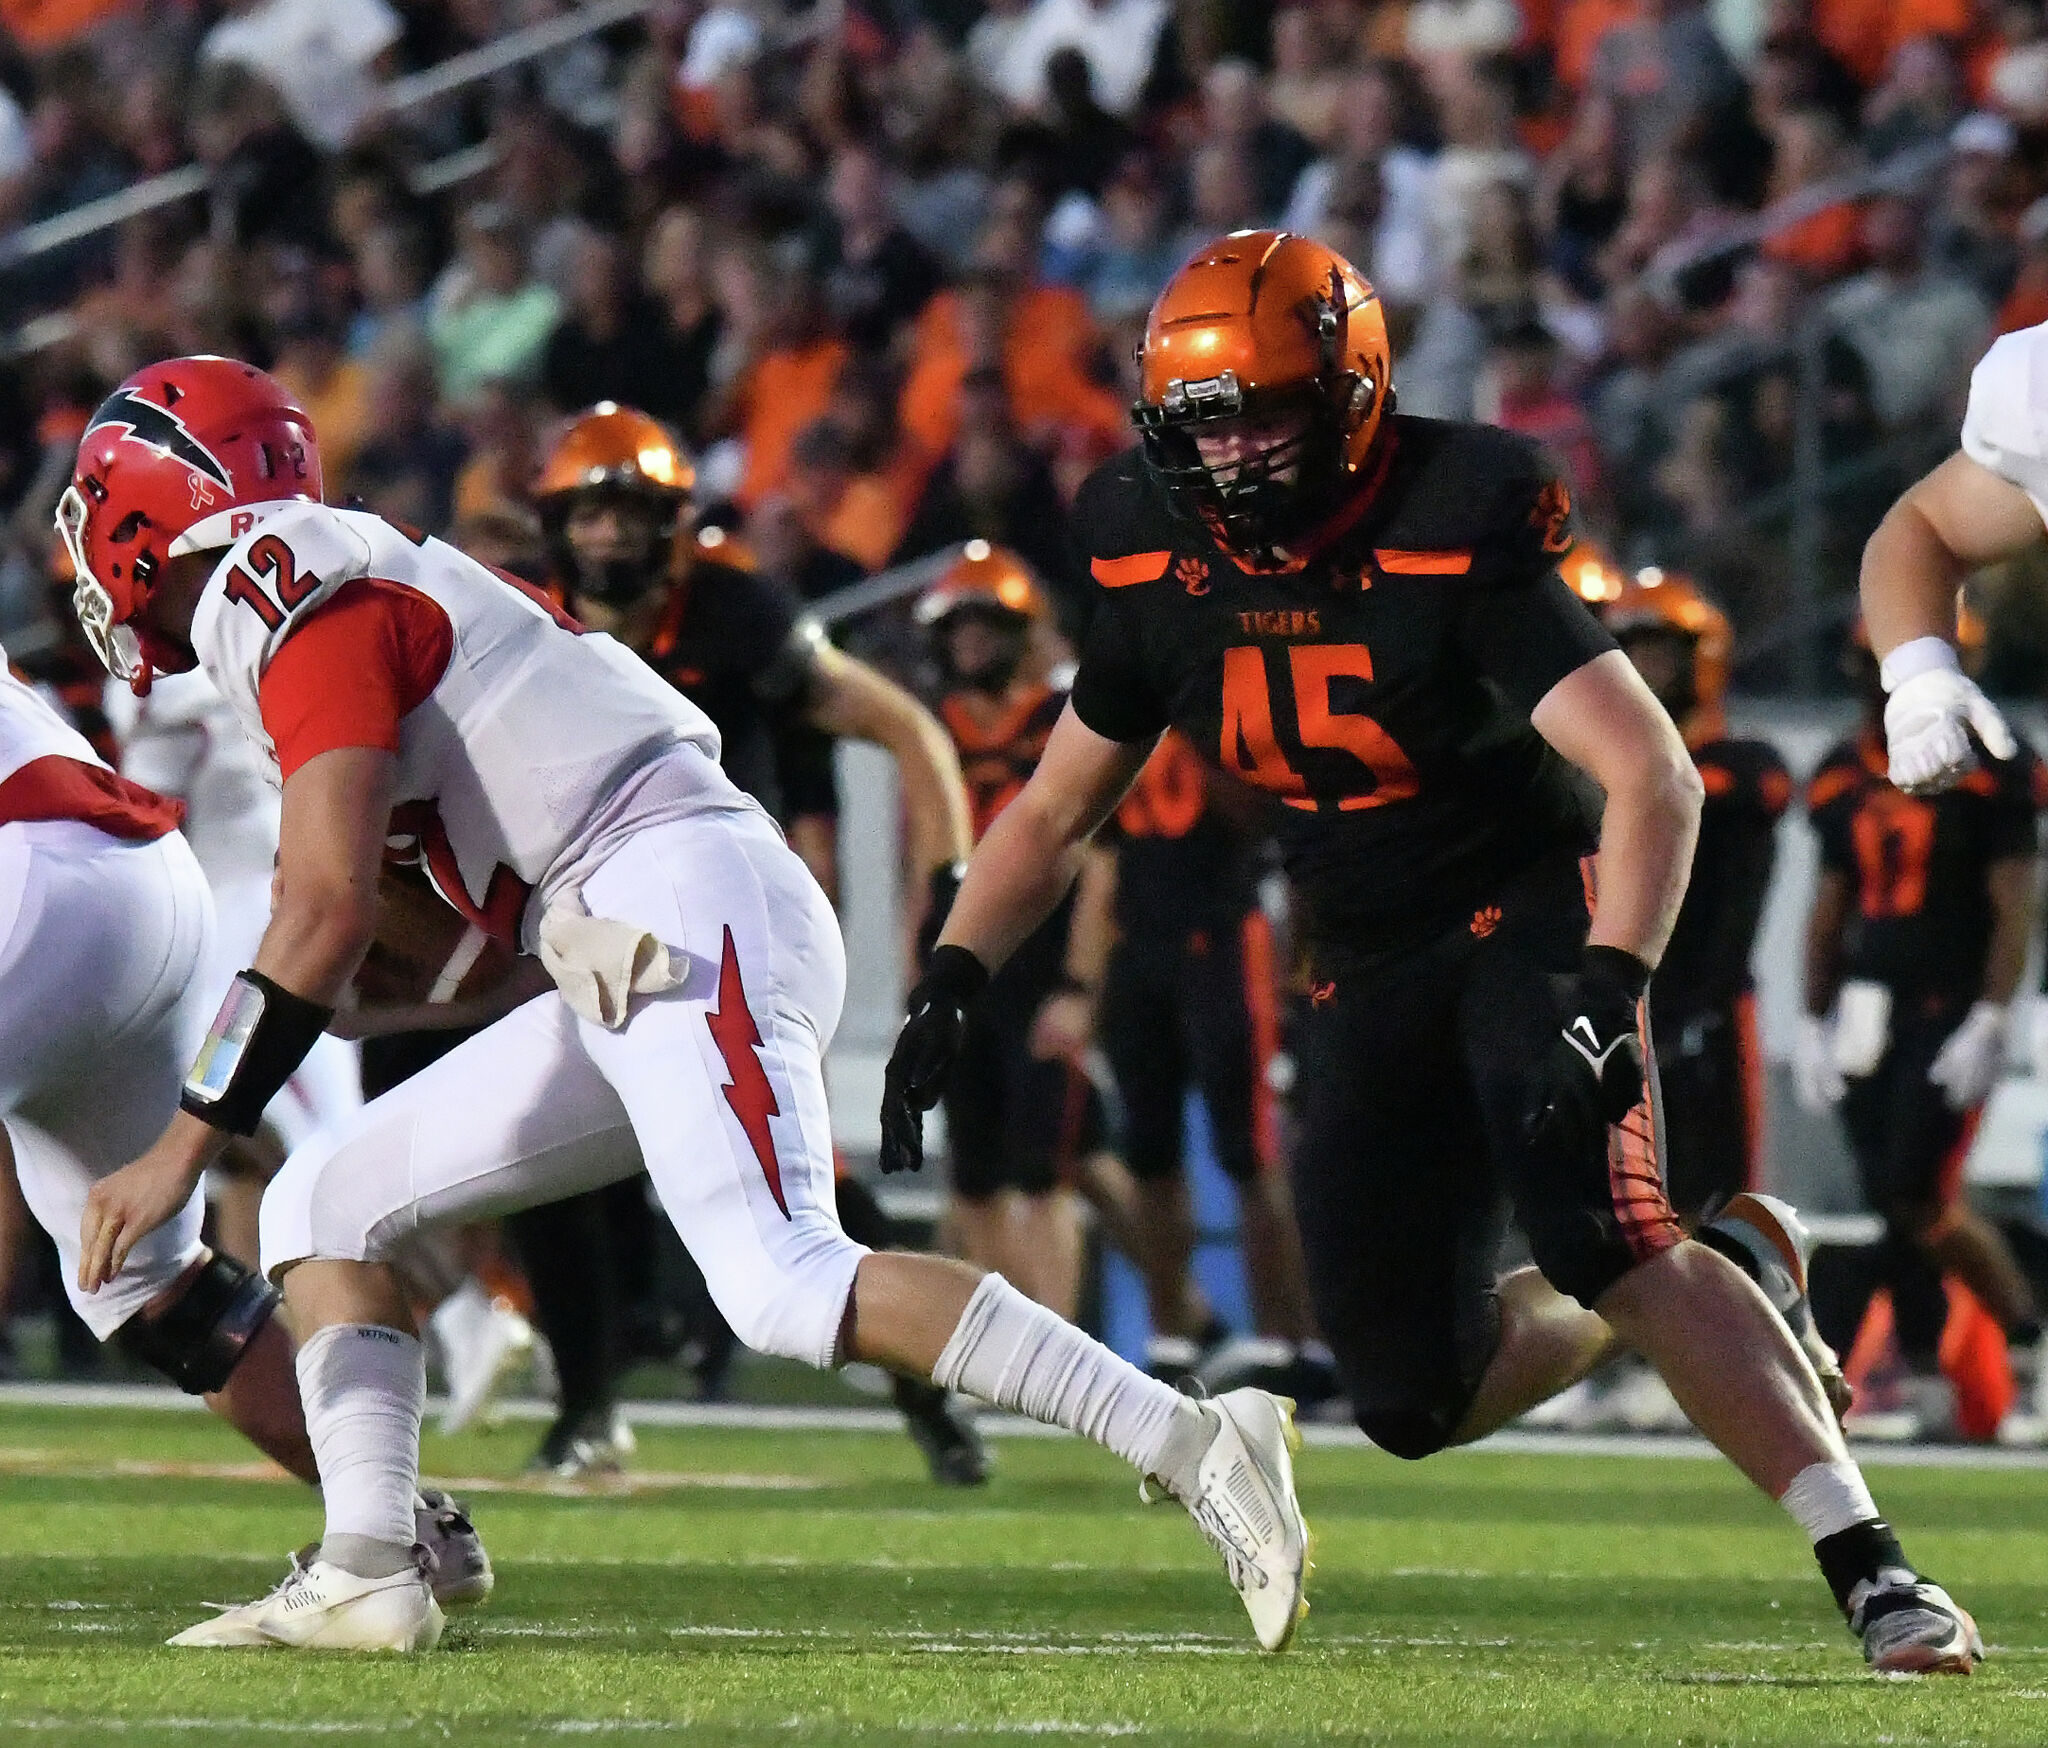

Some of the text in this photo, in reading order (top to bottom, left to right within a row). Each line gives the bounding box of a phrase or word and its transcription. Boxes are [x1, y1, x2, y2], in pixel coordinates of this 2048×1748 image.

[223, 534, 322, 632] 12
[1237, 611, 1321, 634] TIGERS
[1220, 643, 1420, 813] 45
